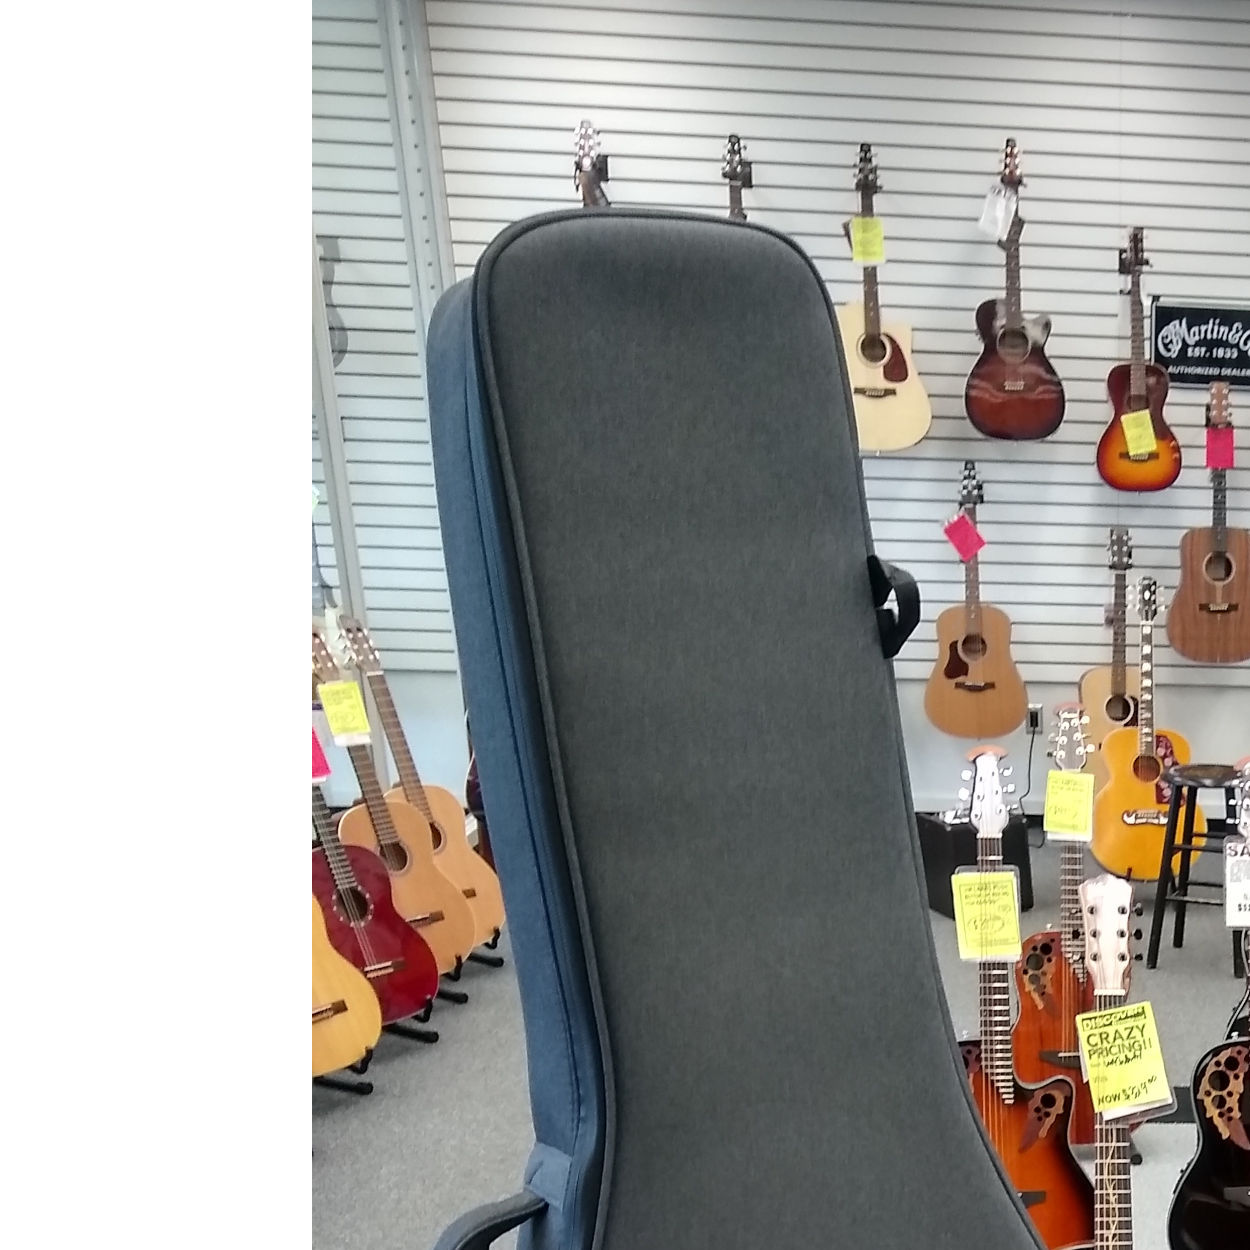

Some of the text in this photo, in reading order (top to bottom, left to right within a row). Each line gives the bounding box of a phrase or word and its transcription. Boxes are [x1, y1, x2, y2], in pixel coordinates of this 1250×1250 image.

[1187, 346, 1210, 358] EST.
[1167, 365, 1220, 376] AUTHORIZED
[1086, 1024, 1146, 1049] CRAZY
[1098, 1092, 1121, 1106] NOW
